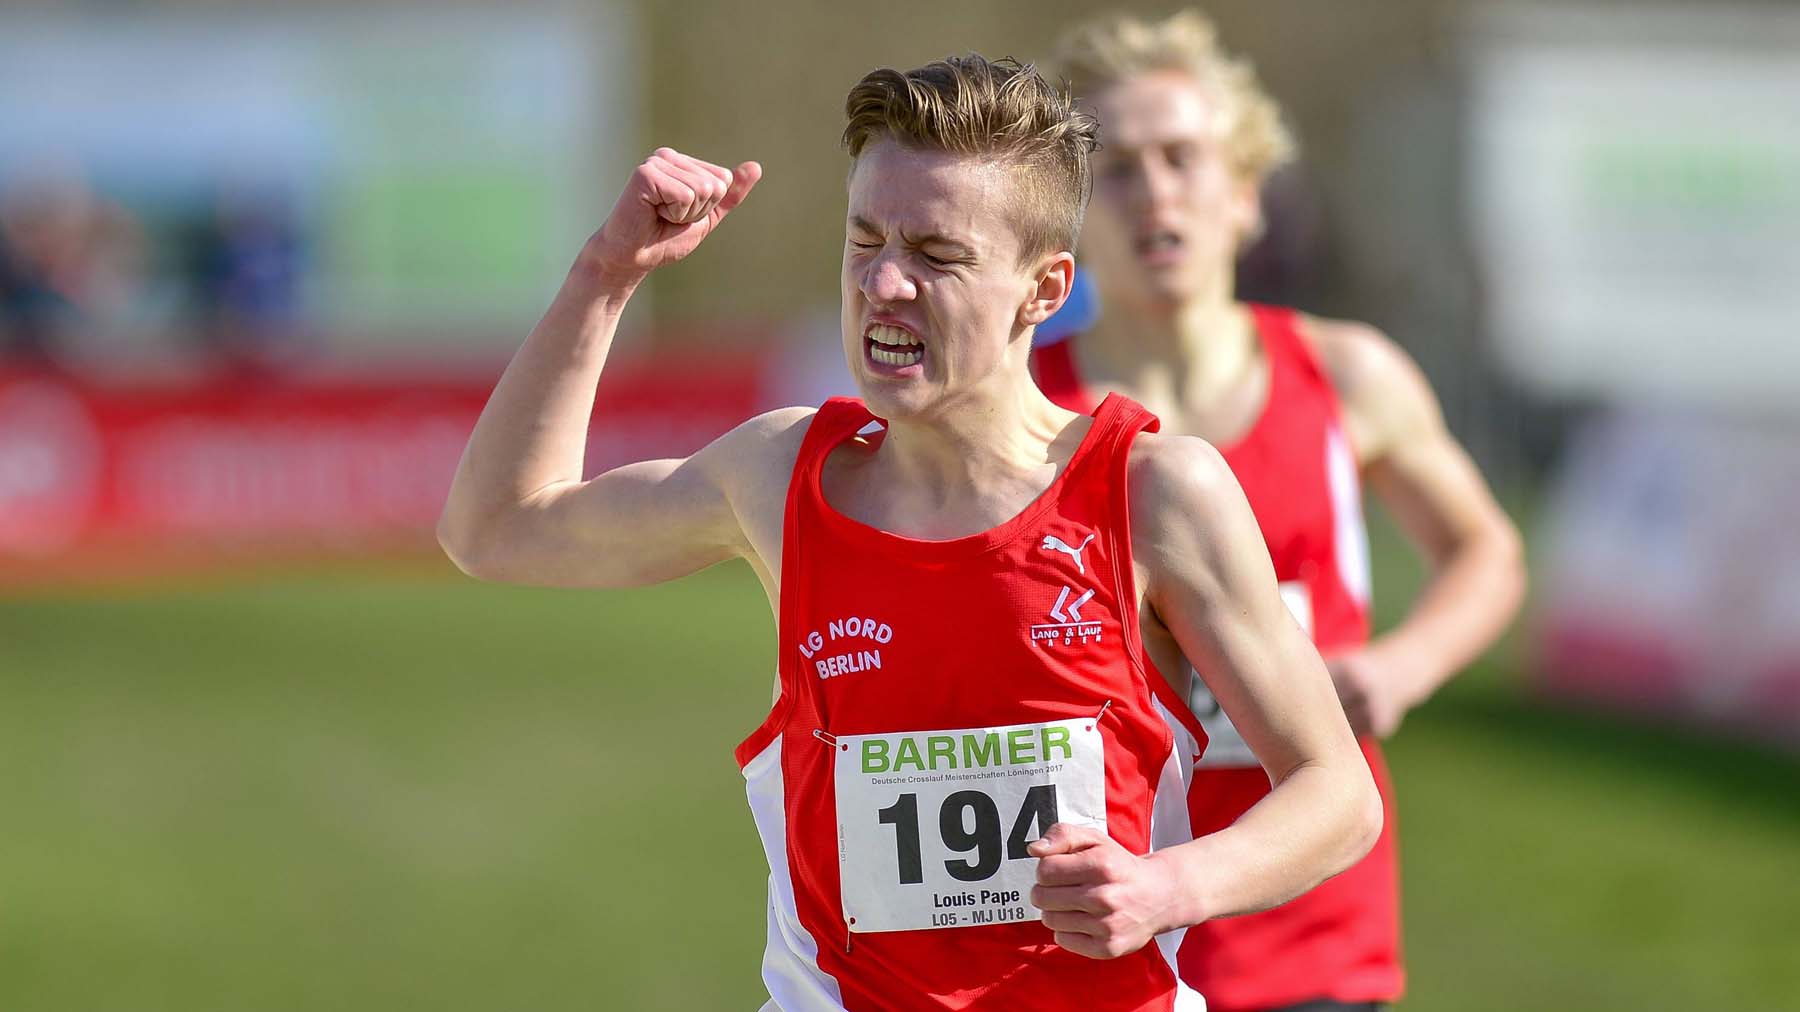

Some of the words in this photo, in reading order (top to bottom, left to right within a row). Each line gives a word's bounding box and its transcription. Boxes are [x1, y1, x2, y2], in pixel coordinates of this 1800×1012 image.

[799, 631, 823, 659] LG
[829, 616, 893, 644] NORD
[1031, 628, 1060, 640] LANG
[1065, 627, 1074, 637] &
[816, 649, 881, 679] BERLIN
[861, 726, 1072, 774] BARMER
[871, 776, 906, 785] Deutsche
[907, 774, 943, 783] Crosslauf
[945, 770, 1006, 781] Meisterschaften
[1046, 764, 1063, 773] 2017
[878, 784, 1059, 884] 194
[933, 892, 976, 908] Louis
[980, 889, 1020, 906] Pape
[932, 912, 957, 927] L05
[972, 909, 993, 923] MJ
[997, 907, 1025, 921] U18
